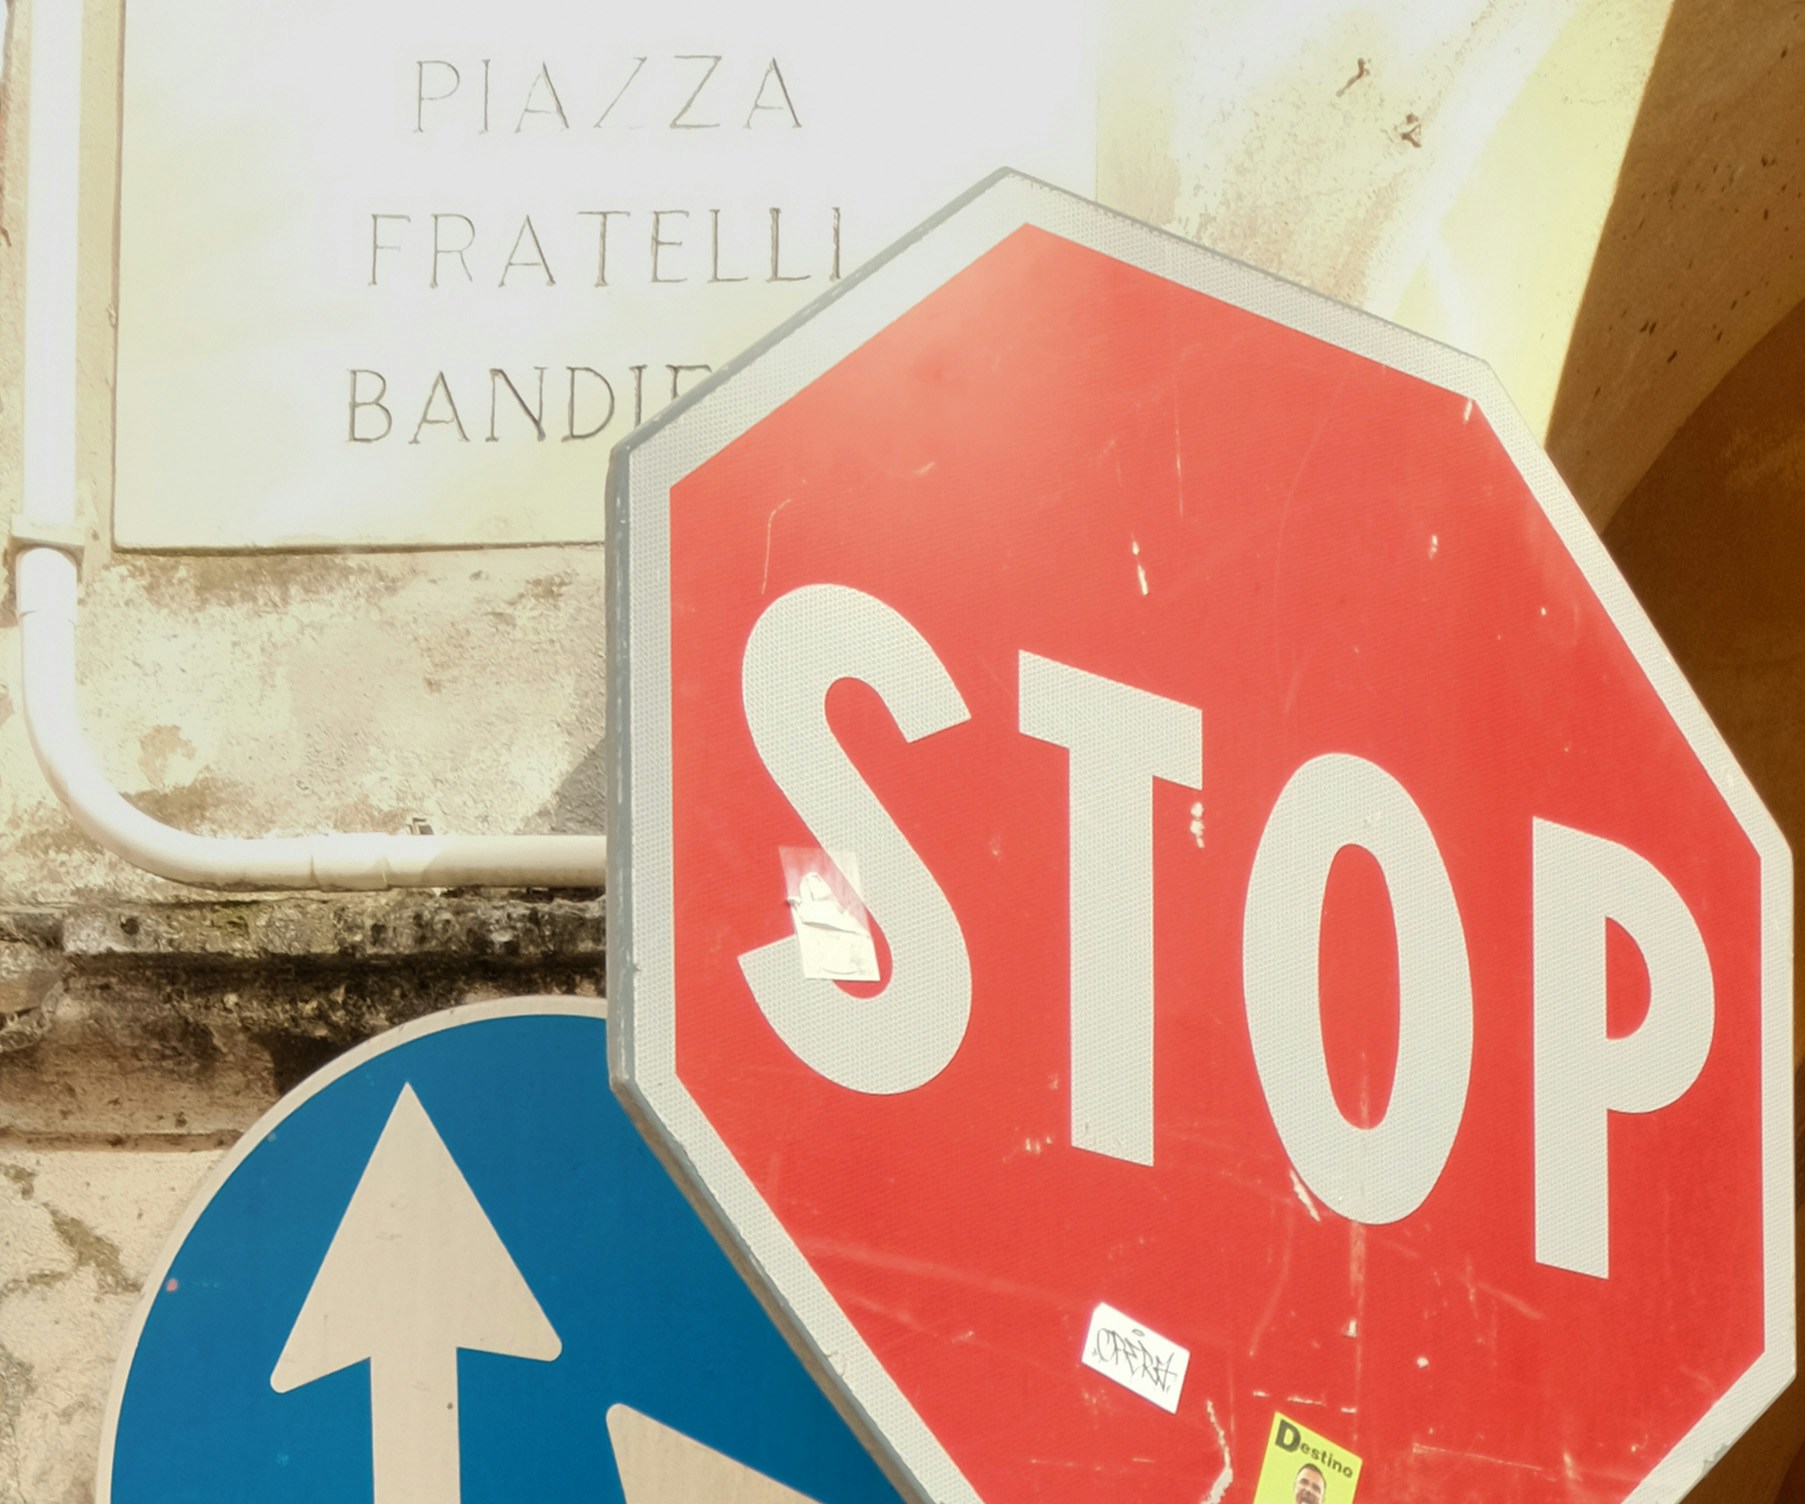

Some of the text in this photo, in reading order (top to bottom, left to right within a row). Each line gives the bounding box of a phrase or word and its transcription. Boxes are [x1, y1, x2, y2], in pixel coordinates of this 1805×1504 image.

[412, 54, 804, 135] PIAZZA
[367, 206, 844, 289] FRATELLI
[737, 583, 1716, 1280] STOP
[1275, 1418, 1354, 1479] Destino
